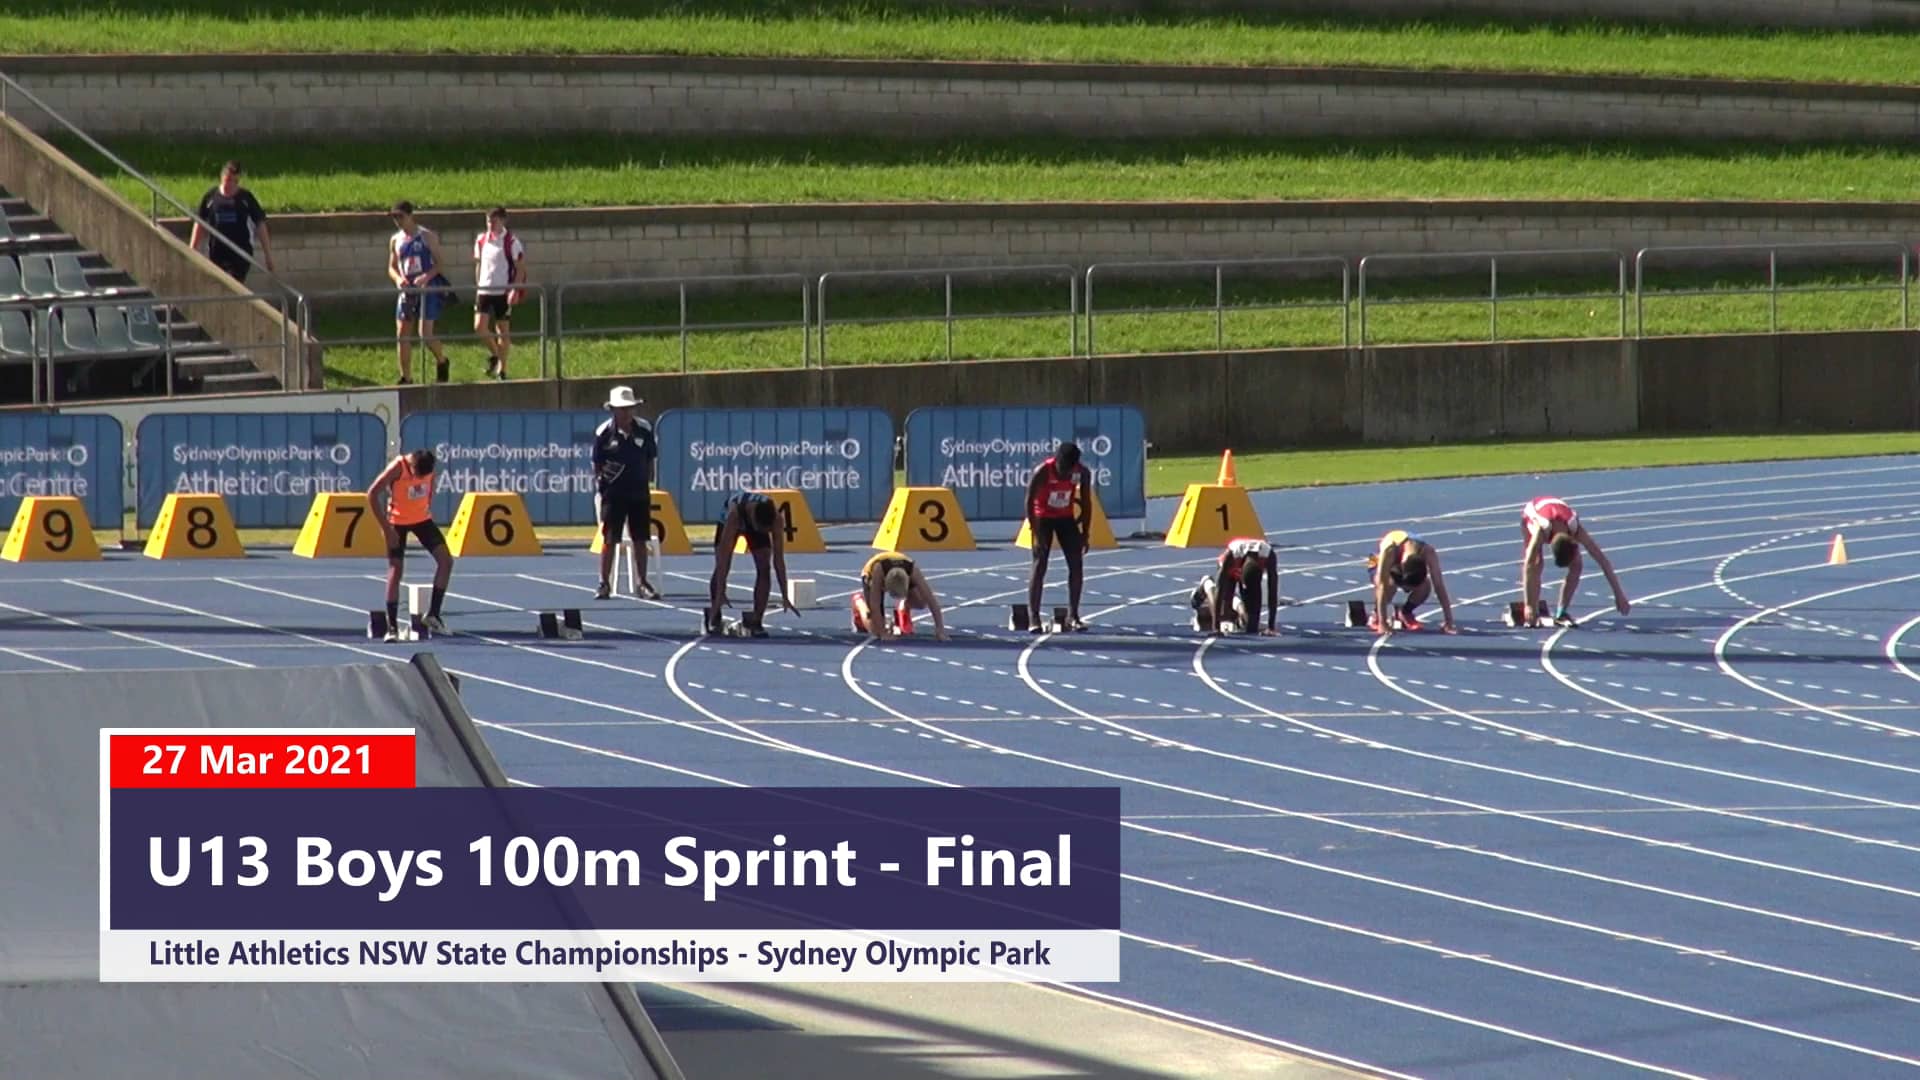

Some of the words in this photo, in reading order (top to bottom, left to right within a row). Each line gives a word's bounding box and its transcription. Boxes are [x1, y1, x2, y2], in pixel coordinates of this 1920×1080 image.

[10, 471, 88, 497] Centre
[175, 469, 269, 496] Athletic
[273, 470, 351, 496] Centre
[436, 467, 528, 494] Athletic
[691, 465, 780, 492] Athletic
[786, 465, 860, 490] Centre
[43, 509, 74, 553] 9
[187, 507, 218, 550] 8
[336, 507, 365, 549] 7
[484, 504, 515, 547] 6
[918, 499, 949, 543] 3
[1215, 503, 1229, 531] 1
